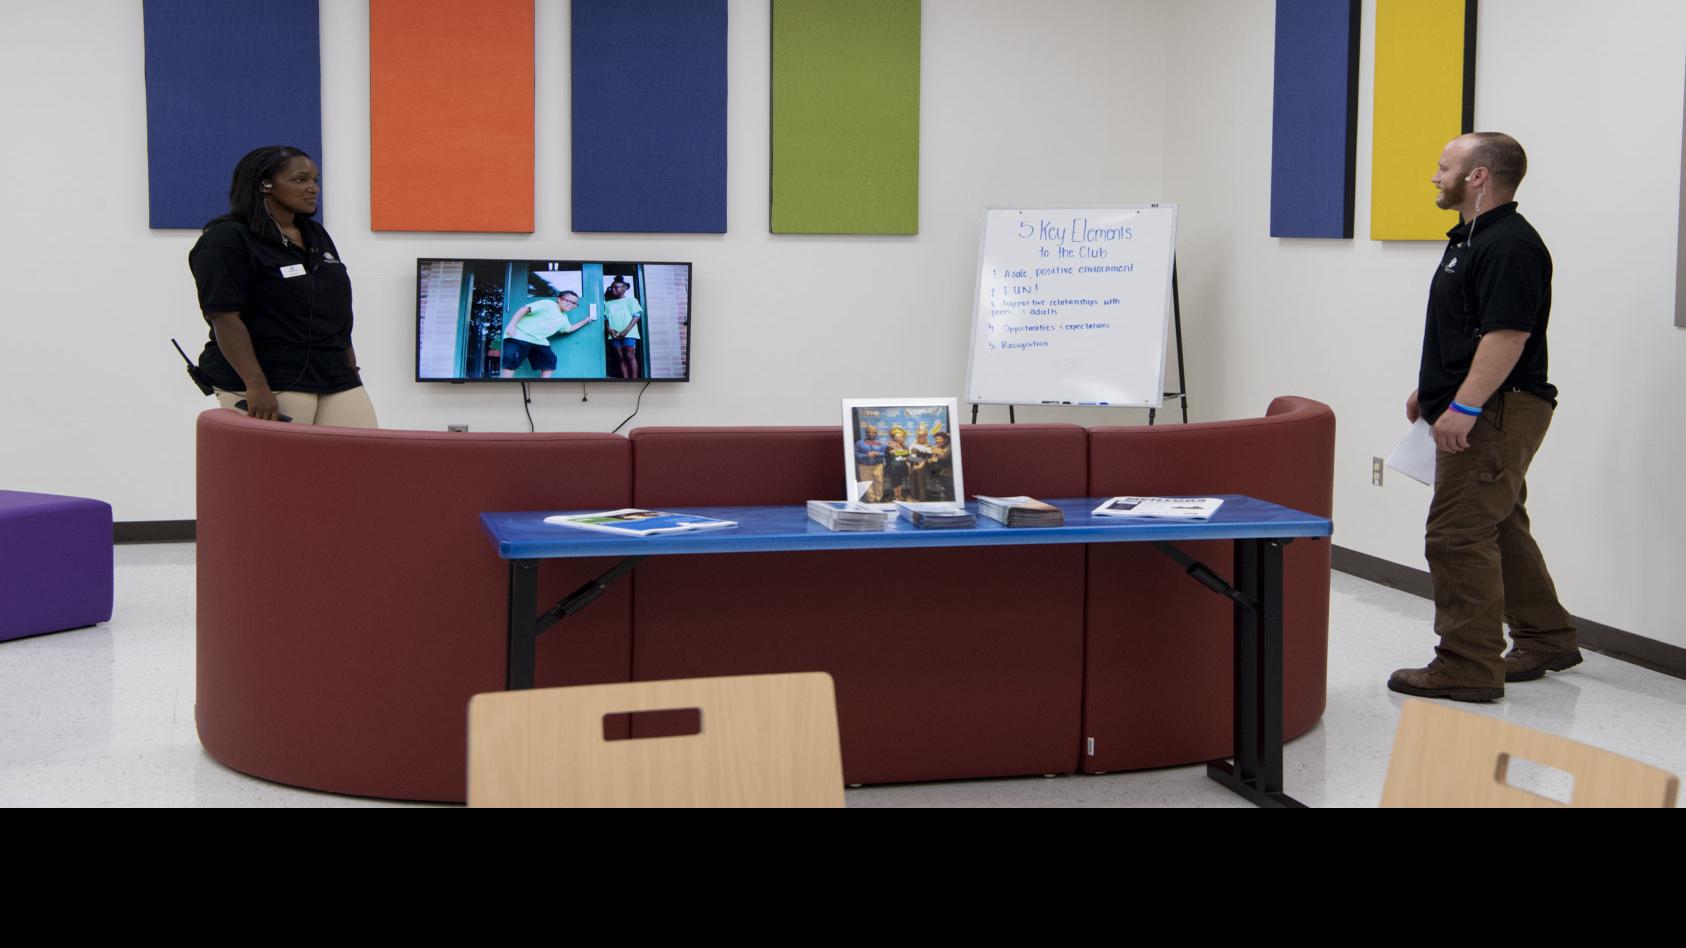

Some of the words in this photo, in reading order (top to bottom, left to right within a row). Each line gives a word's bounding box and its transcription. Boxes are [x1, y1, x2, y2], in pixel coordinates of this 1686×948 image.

[1018, 221, 1034, 239] 5
[1039, 220, 1066, 246] Key
[1071, 219, 1133, 243] Elements
[1040, 247, 1050, 258] to
[1058, 247, 1075, 258] the
[1079, 247, 1107, 258] Club
[1036, 267, 1073, 278] positive
[1103, 298, 1121, 306] with
[1001, 340, 1048, 351] Recognition
